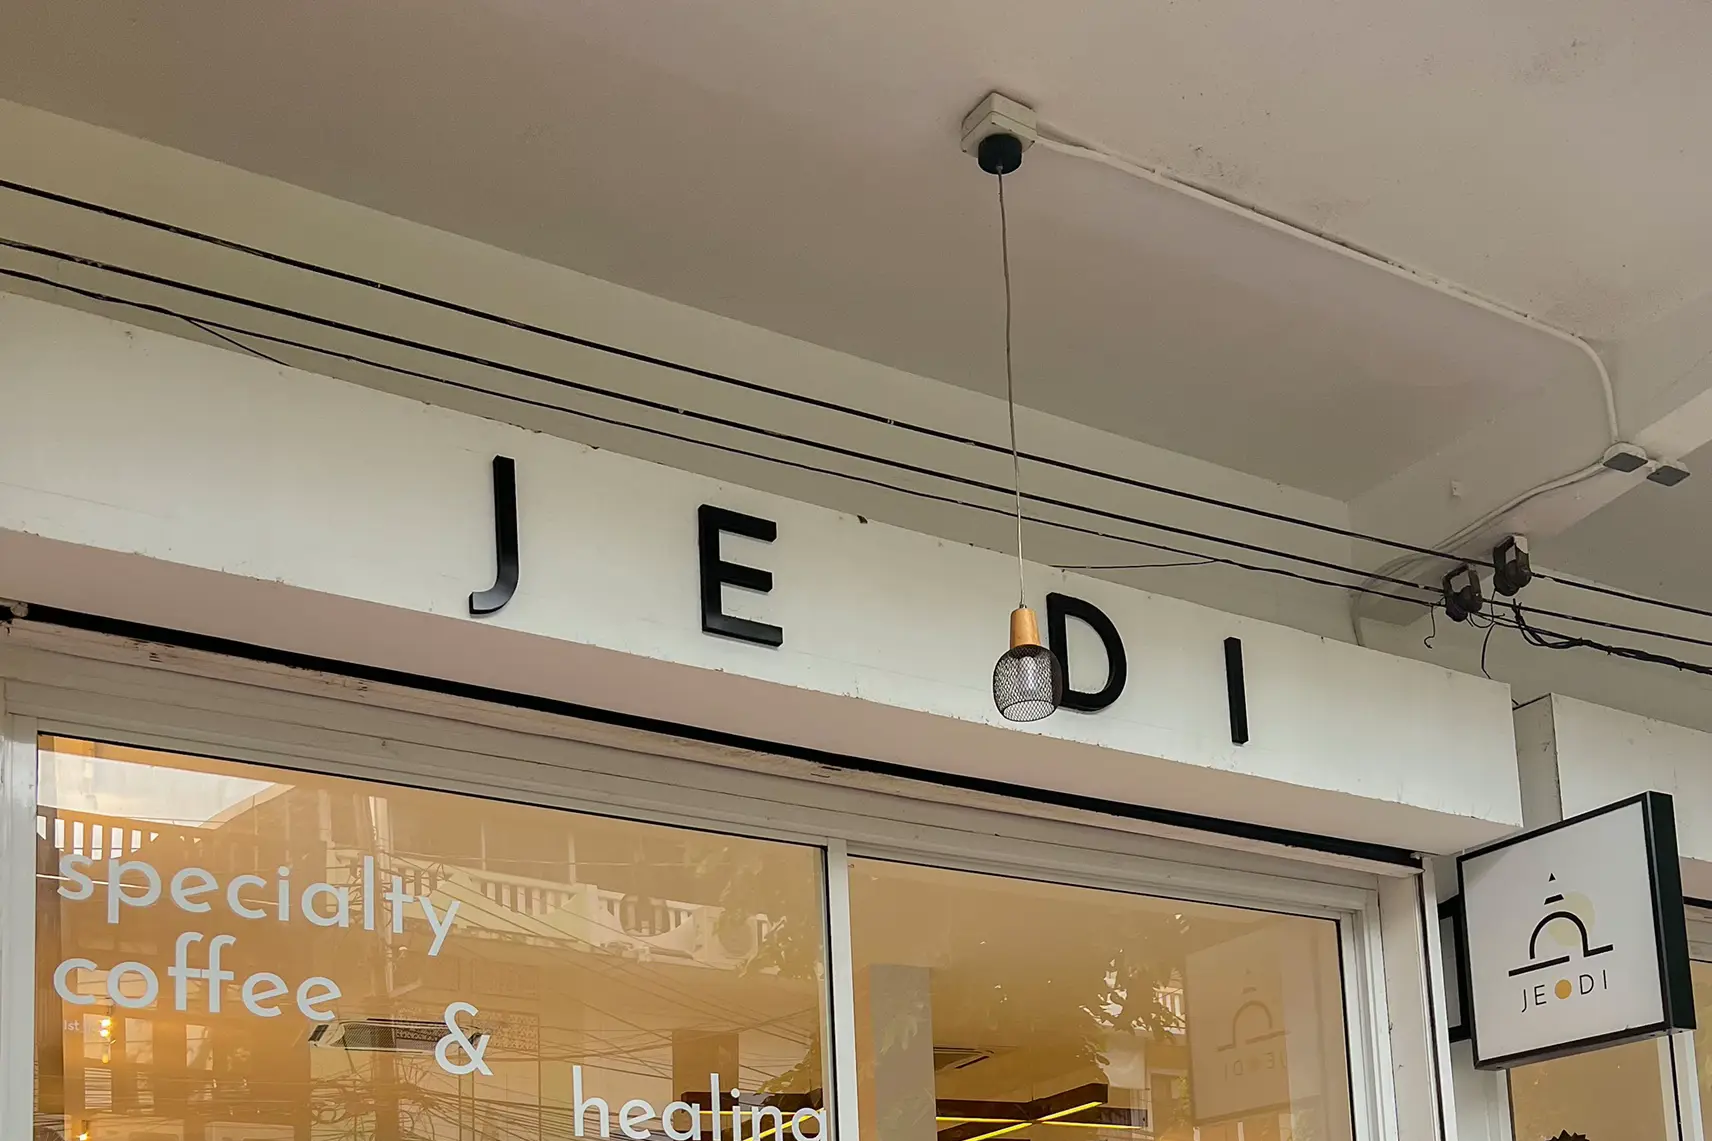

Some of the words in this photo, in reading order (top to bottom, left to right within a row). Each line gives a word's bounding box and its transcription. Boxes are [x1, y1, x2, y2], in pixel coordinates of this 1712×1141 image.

[57, 854, 461, 956] specialty
[53, 932, 342, 1021] coffee
[435, 1002, 494, 1076] &
